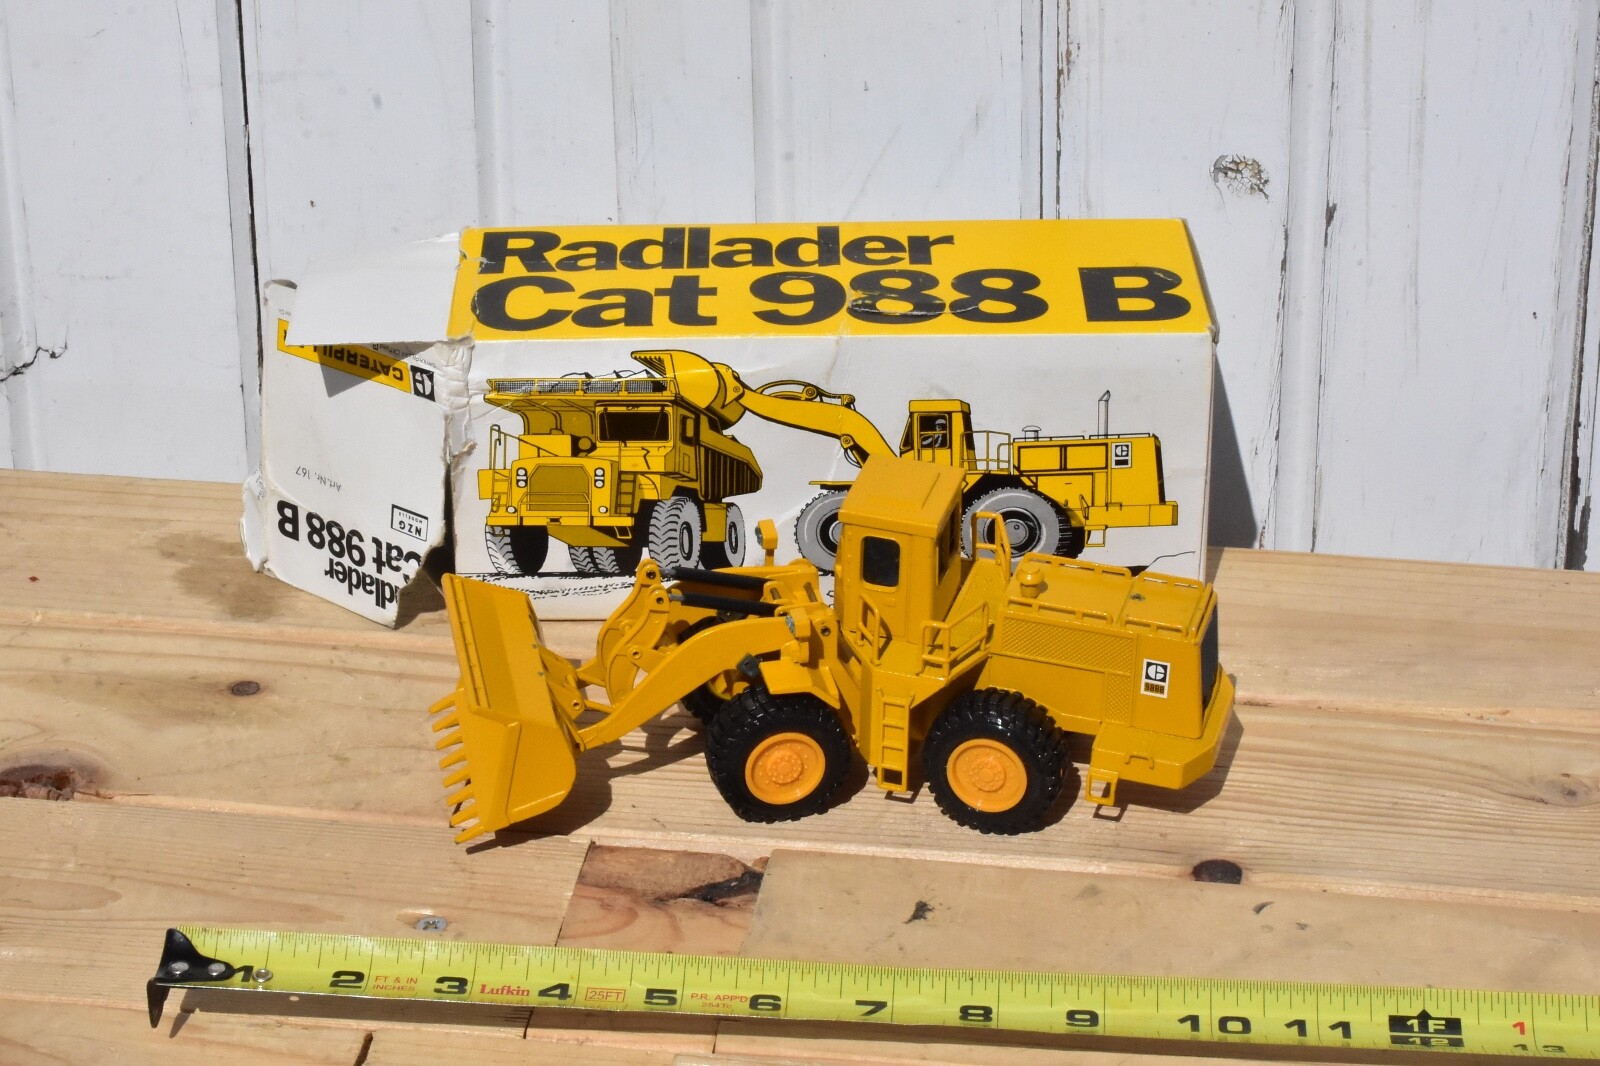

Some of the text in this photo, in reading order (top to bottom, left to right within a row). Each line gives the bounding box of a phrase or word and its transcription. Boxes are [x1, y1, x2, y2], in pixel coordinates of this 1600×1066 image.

[479, 226, 954, 274] Radlader
[471, 266, 1192, 331] Cat 988 B
[295, 466, 311, 479] 167
[277, 500, 300, 542] B
[398, 520, 422, 537] NZG
[306, 511, 366, 567] 988
[233, 965, 254, 982] 1
[330, 970, 365, 989] 2
[375, 975, 388, 983] FT
[406, 977, 418, 985] IN
[433, 976, 469, 995] 3
[479, 984, 530, 997] Lufkin
[538, 983, 572, 1001] 4
[588, 990, 623, 1001] 25FT
[644, 988, 678, 1007] 5
[714, 994, 748, 1003] APP'D
[749, 994, 782, 1011] 6
[855, 999, 888, 1016] 7
[959, 1004, 993, 1022] 8
[1065, 1009, 1099, 1027] 9
[1406, 1019, 1447, 1033] 1F
[1512, 1021, 1526, 1036] 1
[1408, 1037, 1450, 1046] 12
